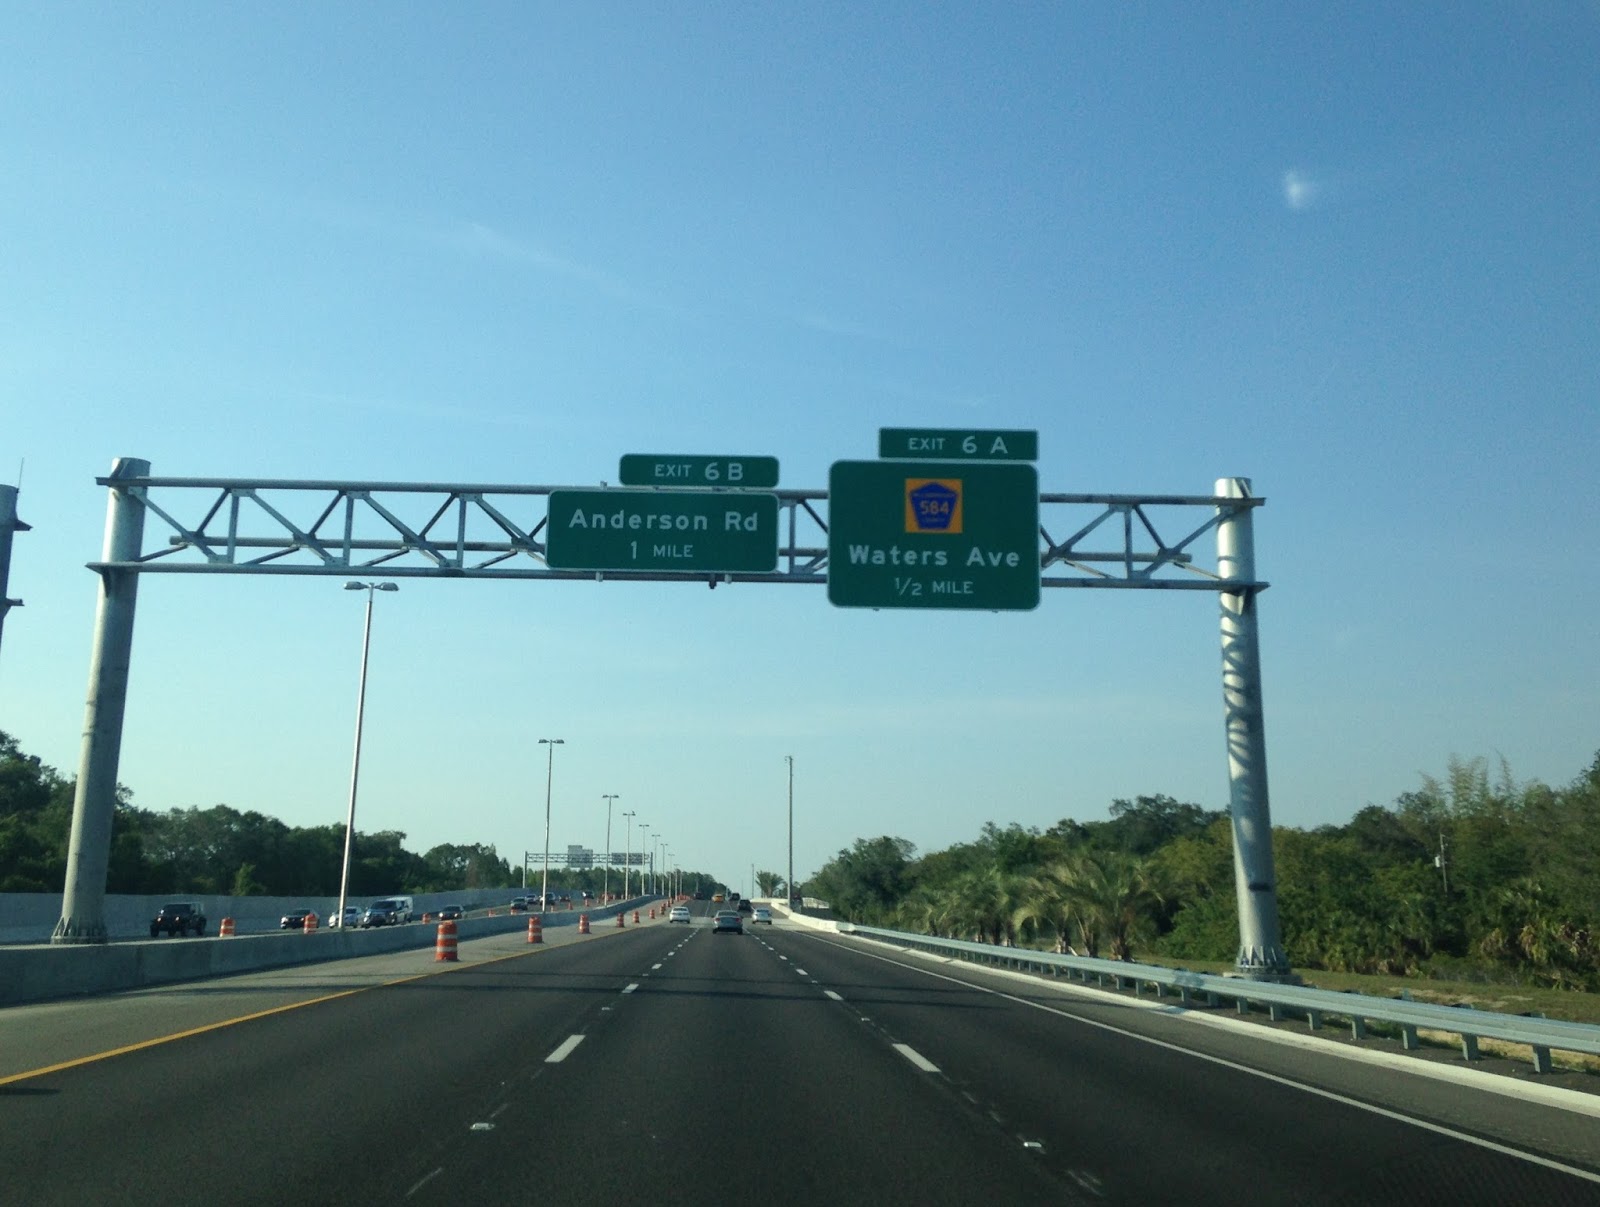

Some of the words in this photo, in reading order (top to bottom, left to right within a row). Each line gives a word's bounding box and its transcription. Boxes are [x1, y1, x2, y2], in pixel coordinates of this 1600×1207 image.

[908, 437, 946, 451] EXIT
[654, 463, 692, 478] EXIT
[920, 500, 949, 515] 584
[568, 508, 708, 530] Anderson
[724, 511, 758, 531] Rd
[630, 540, 638, 560] 1
[653, 544, 694, 558] MILE
[849, 544, 948, 566] Waters
[966, 546, 1020, 567] Ave
[895, 577, 923, 596] 1/2
[932, 581, 974, 594] MILE
